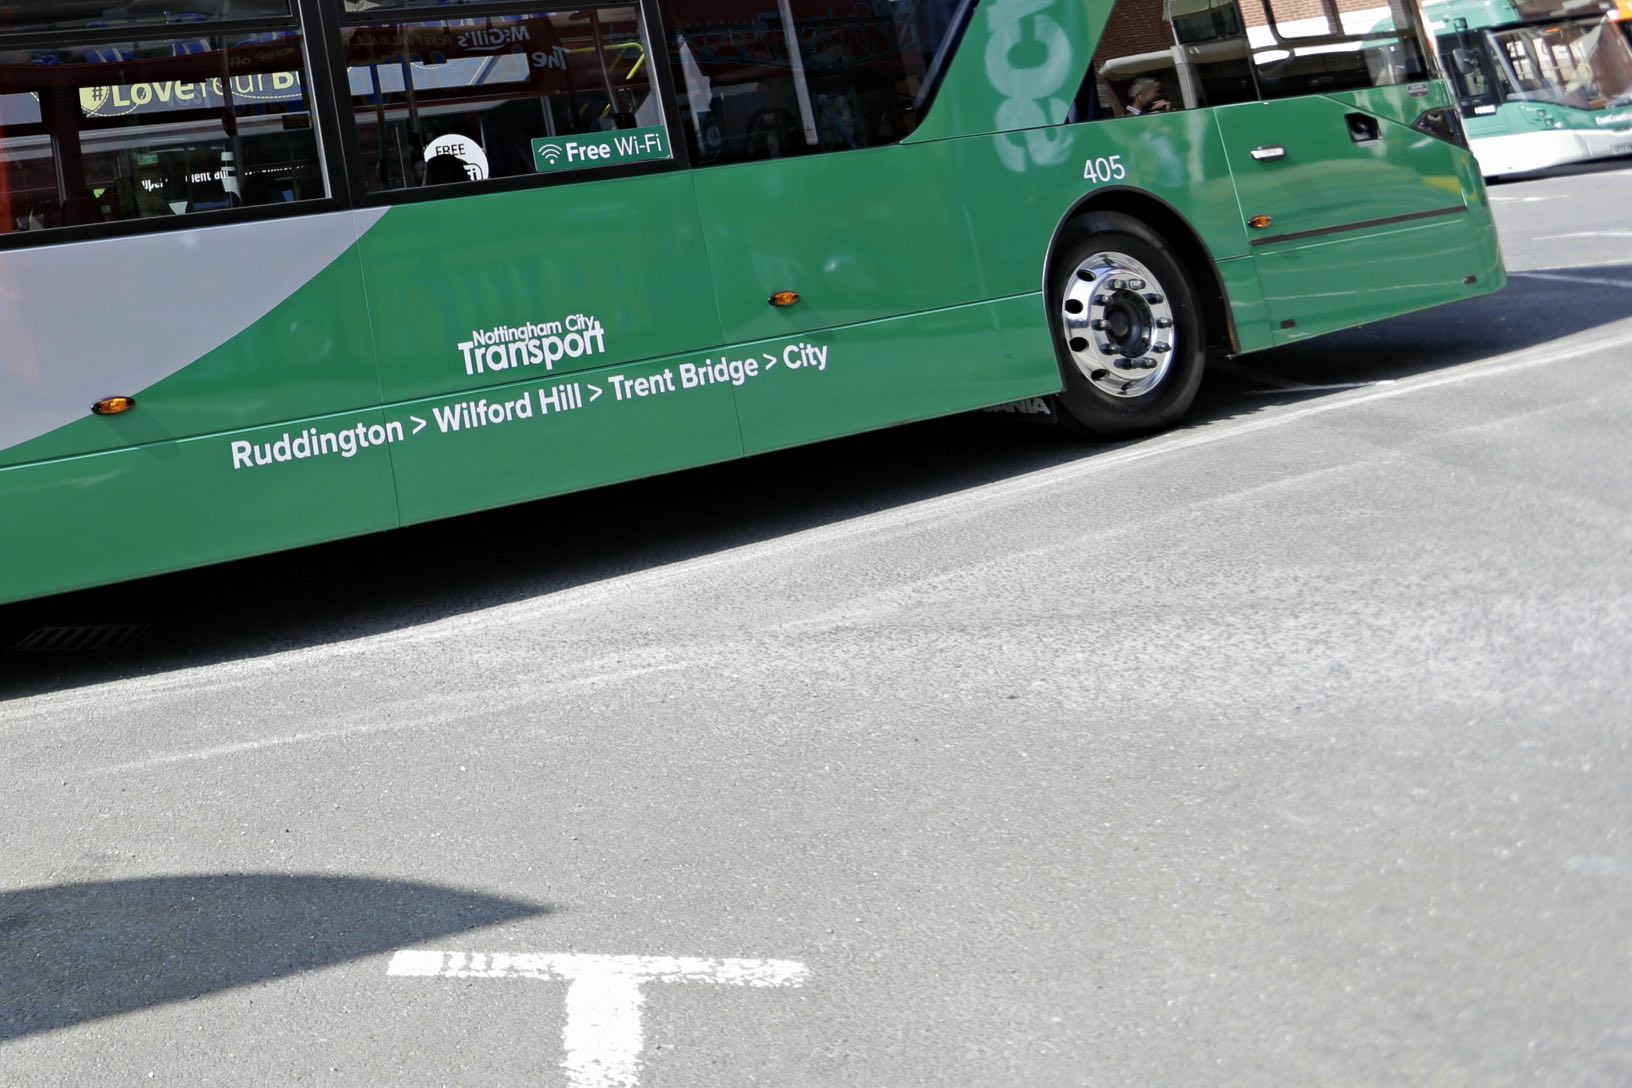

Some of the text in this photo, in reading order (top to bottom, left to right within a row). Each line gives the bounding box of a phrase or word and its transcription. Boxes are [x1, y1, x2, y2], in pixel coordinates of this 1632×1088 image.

[565, 132, 663, 163] Free Wi-Fi
[1082, 154, 1127, 184] 405
[472, 313, 595, 347] Nottingham City
[457, 320, 606, 376] Transport
[229, 340, 830, 470] Ruddington Wilford Hill Trent Bridge City
